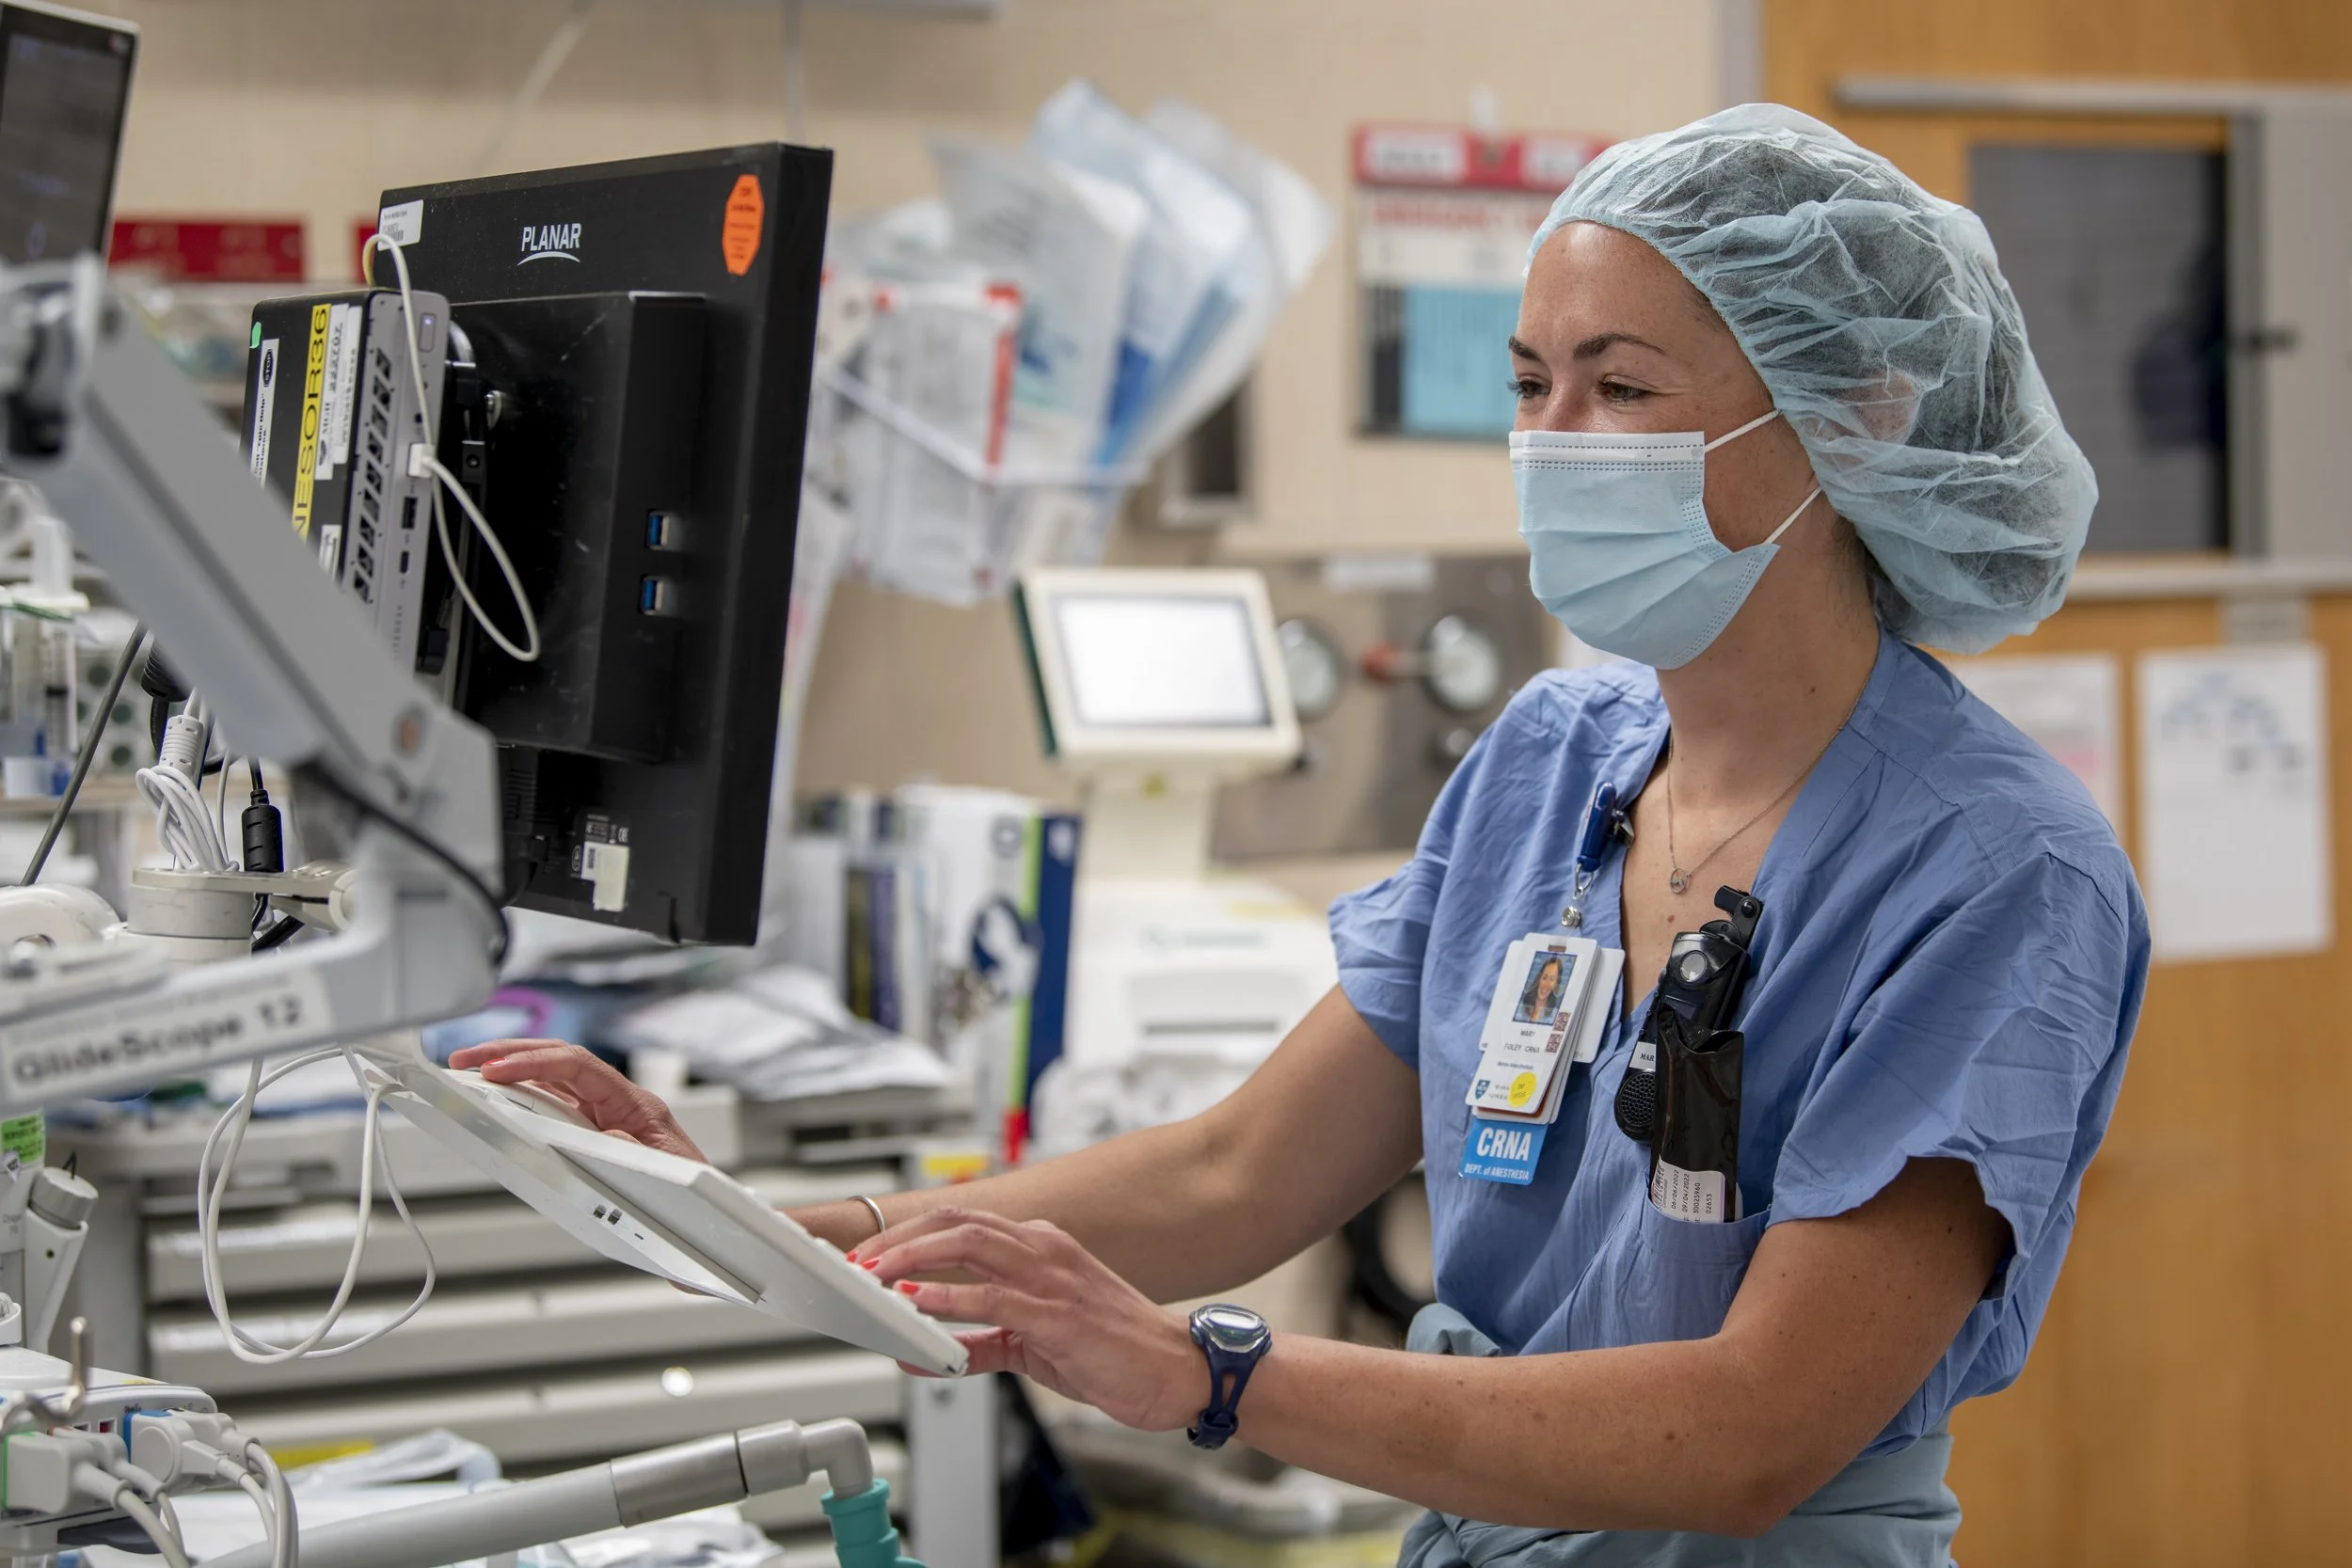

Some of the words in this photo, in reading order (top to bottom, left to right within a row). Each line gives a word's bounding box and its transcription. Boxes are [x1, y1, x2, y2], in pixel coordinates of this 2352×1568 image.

[521, 223, 581, 251] PLANAR
[13, 1014, 244, 1085] GlideScope
[258, 995, 301, 1027] 12
[1640, 1053, 1655, 1062] MAR
[1476, 1127, 1532, 1162] CRNA
[1464, 1163, 1483, 1175] DEPT.
[1483, 1166, 1491, 1176] of
[1490, 1166, 1530, 1180] ANESTHESIA
[1671, 1169, 1679, 1210] 06/06/2022
[1692, 1182, 1701, 1213] 30025960
